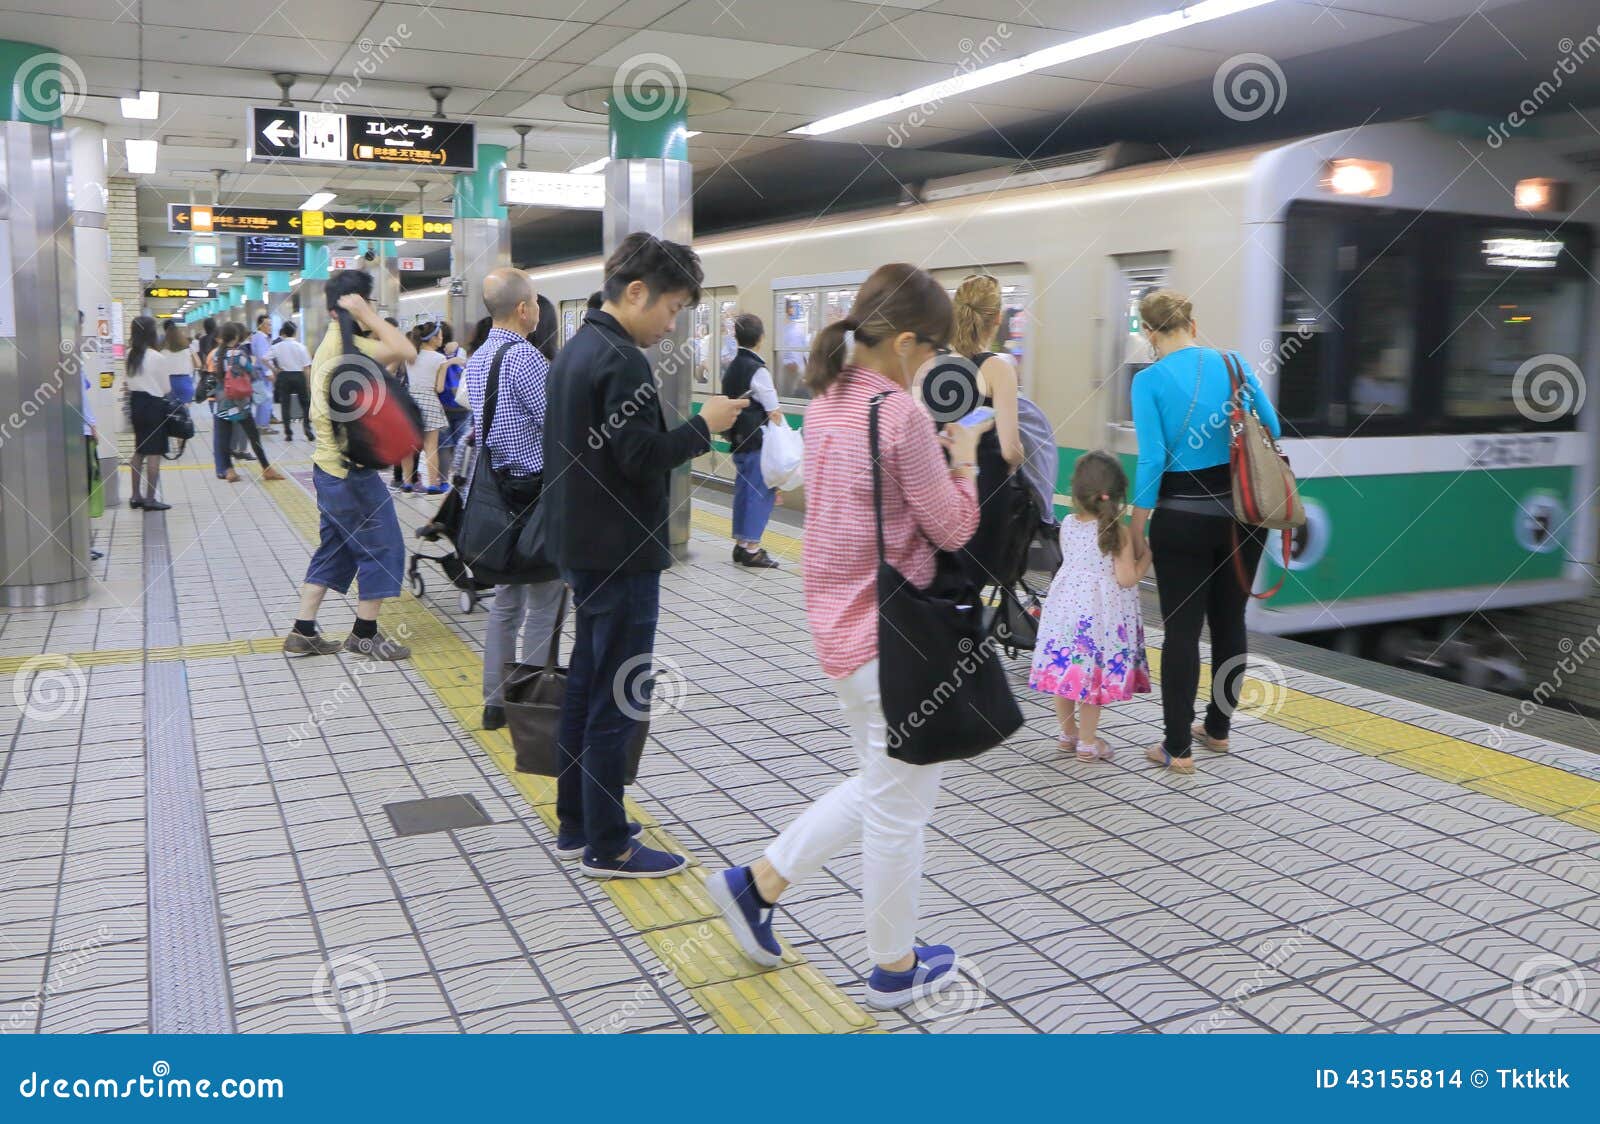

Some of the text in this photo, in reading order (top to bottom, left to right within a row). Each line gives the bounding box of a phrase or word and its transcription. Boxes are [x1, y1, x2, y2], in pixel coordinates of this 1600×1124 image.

[365, 121, 434, 140] エレベータ
